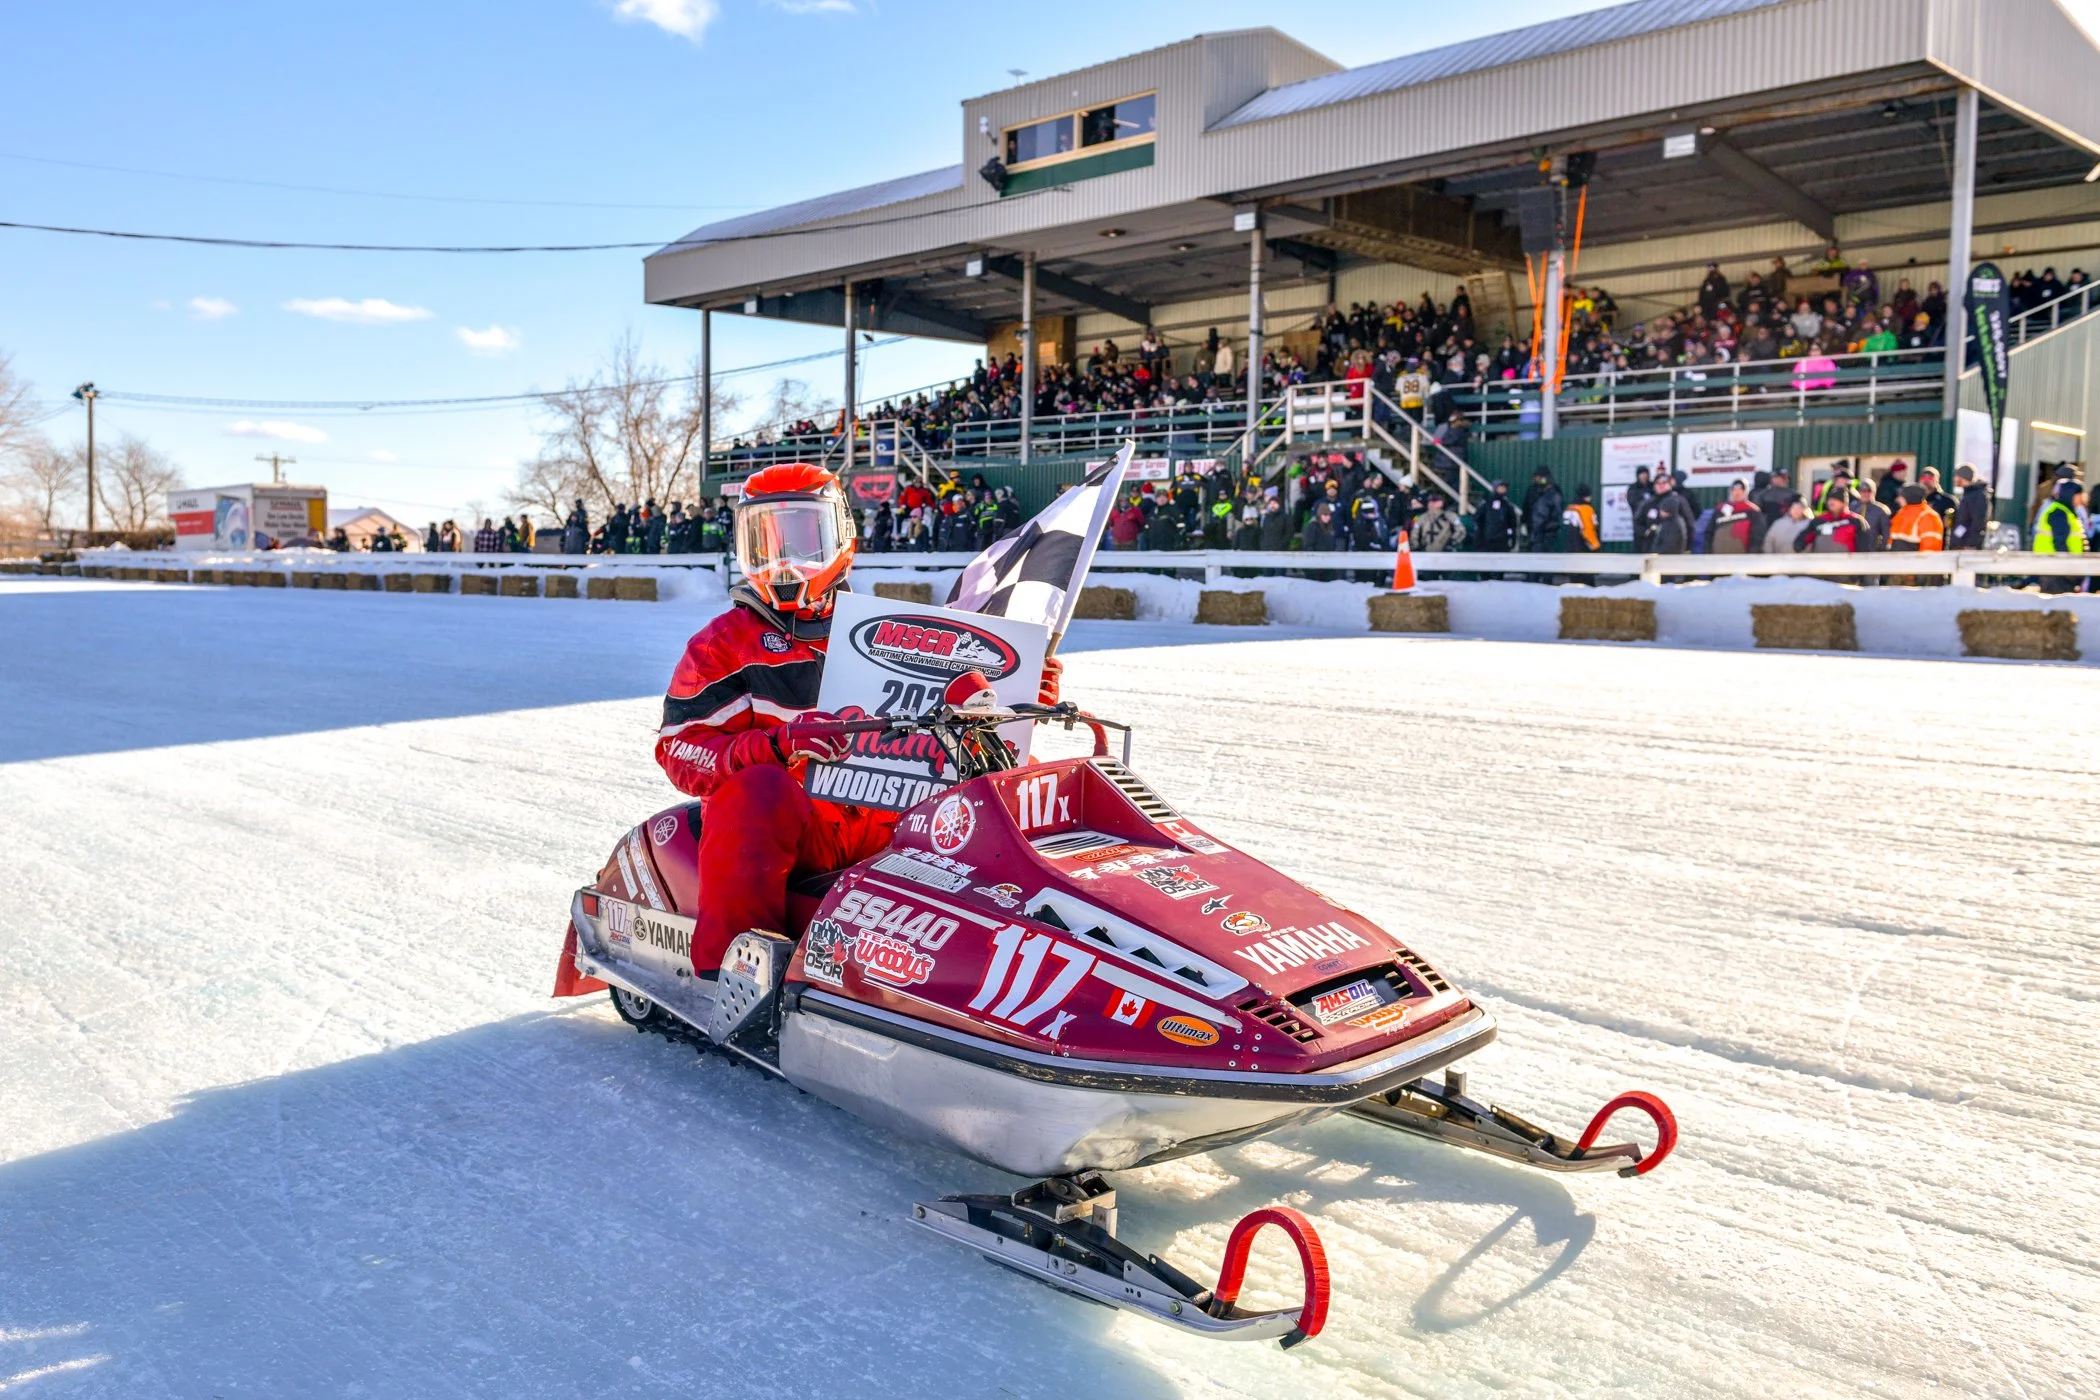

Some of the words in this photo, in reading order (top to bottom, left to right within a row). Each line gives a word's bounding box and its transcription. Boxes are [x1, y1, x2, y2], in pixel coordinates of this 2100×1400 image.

[873, 620, 959, 656] MSCR
[868, 648, 902, 661] MARITIME
[904, 654, 949, 669] SNOWMOBILE
[874, 679, 945, 719] 202
[668, 737, 718, 771] YAMAHA
[811, 763, 954, 809] WOODSTO
[1161, 880, 1210, 894] OSOR
[831, 889, 960, 951] SS440
[647, 919, 694, 958] YAMAH
[862, 932, 908, 951] TEAM
[1233, 921, 1372, 976] YAMAHA
[806, 952, 843, 980] OSOR
[1316, 982, 1374, 1014] AMSOIL
[1161, 1020, 1213, 1041] Ultimax
